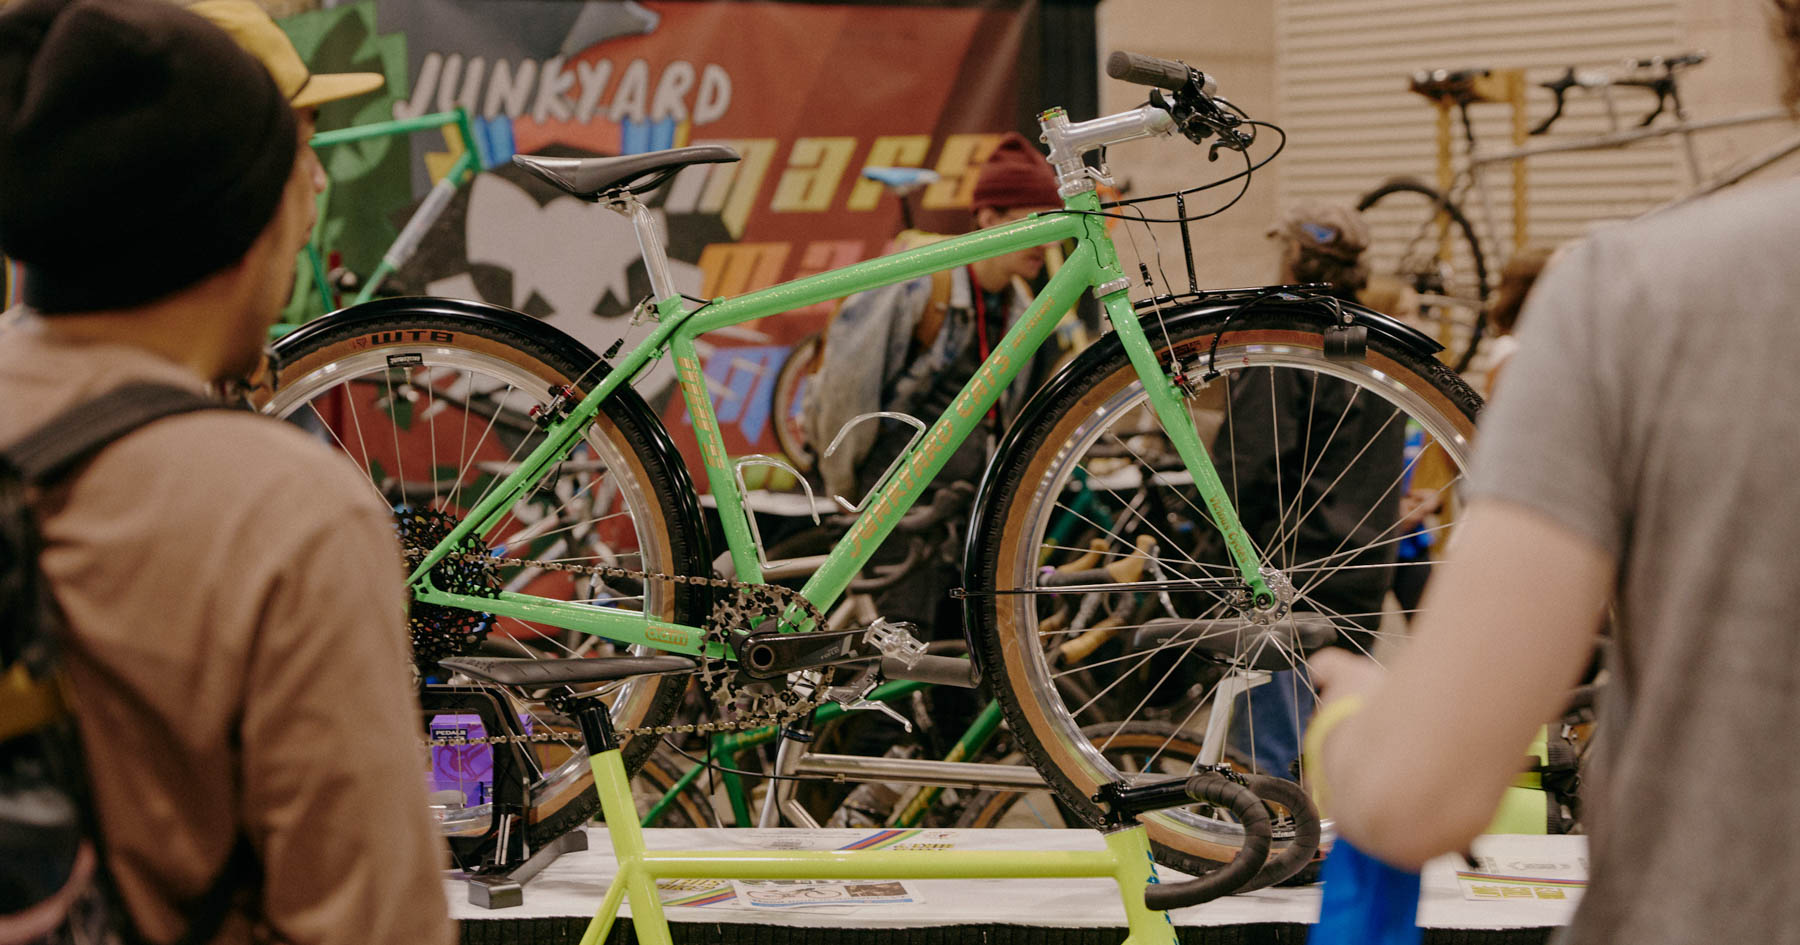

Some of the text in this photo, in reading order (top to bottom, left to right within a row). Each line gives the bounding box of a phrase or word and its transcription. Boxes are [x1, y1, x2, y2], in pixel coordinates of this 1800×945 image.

[393, 51, 732, 126] JUNKYARD
[371, 330, 454, 344] WTB
[849, 346, 1011, 558] JUNKYARD CATS
